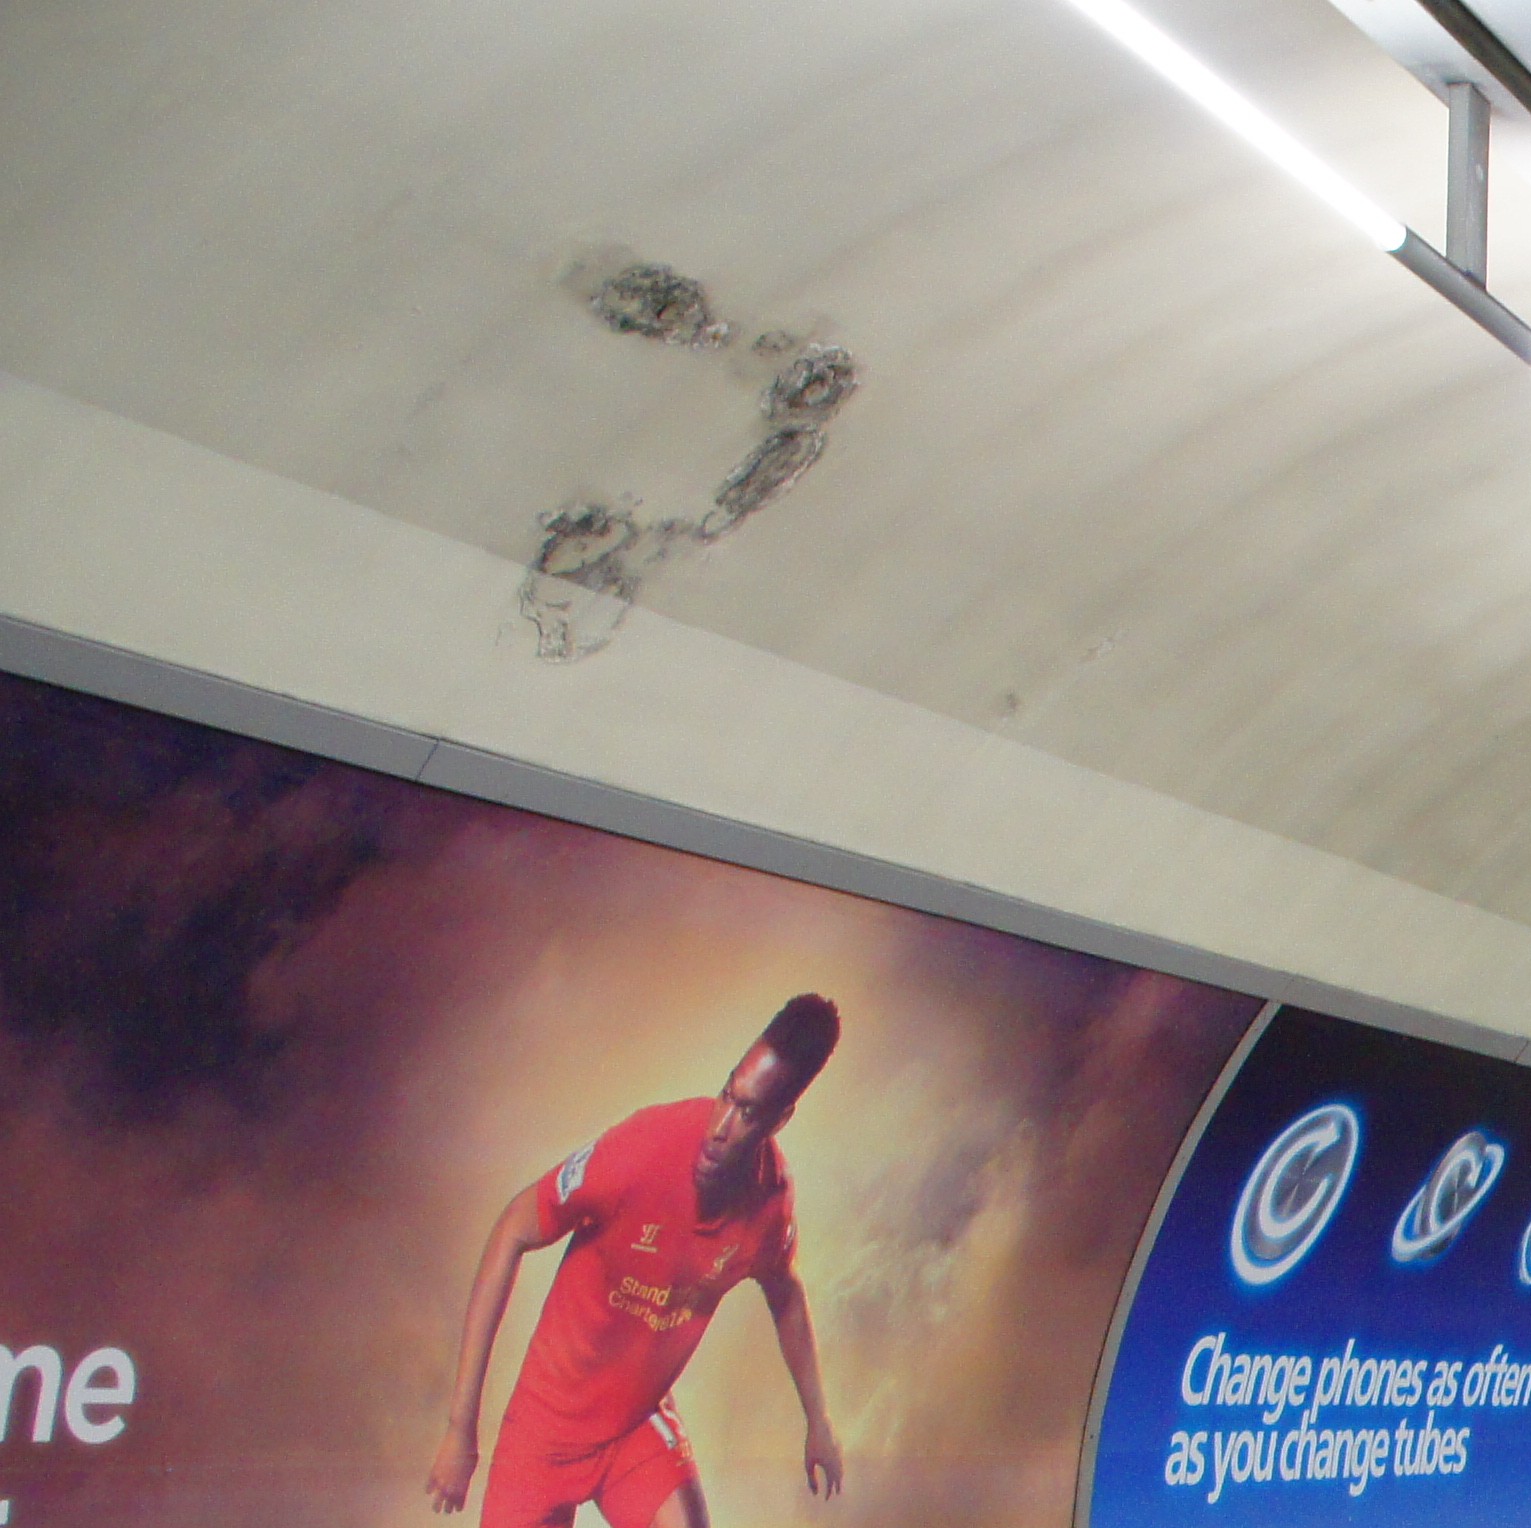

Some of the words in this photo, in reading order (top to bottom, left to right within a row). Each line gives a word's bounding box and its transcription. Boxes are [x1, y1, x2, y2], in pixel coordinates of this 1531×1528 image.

[1182, 1332, 1312, 1425] Change
[1309, 1338, 1428, 1424] phones
[1426, 1360, 1463, 1407] as
[1164, 1430, 1208, 1486] as
[1207, 1430, 1278, 1504] you
[1279, 1410, 1391, 1497] change
[1393, 1409, 1471, 1477] tubes
